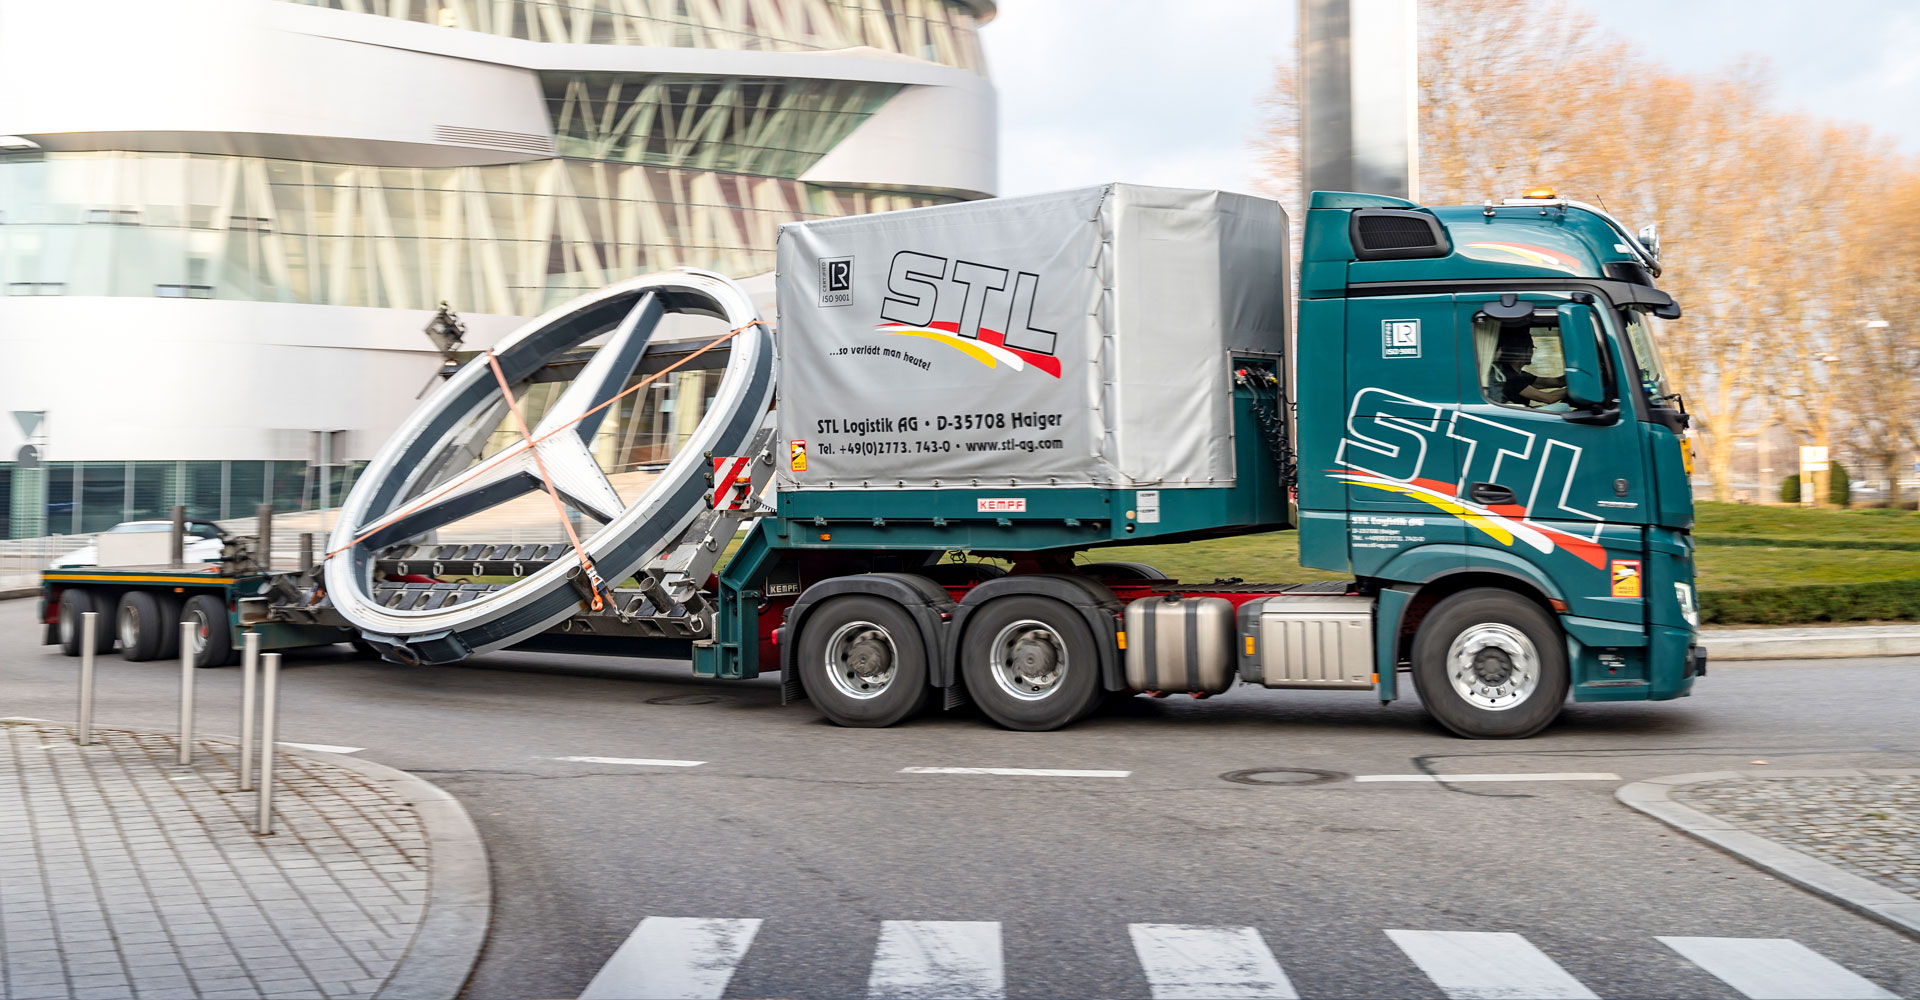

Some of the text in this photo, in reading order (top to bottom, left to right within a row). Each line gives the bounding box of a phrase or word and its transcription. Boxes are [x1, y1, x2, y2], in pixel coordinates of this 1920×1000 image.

[822, 294, 850, 303] ISO 9001
[880, 250, 1058, 356] STL
[851, 345, 880, 356] verlädt
[883, 347, 901, 359] man
[903, 352, 932, 371] heute!
[817, 411, 1063, 437] STL Logistik AG D-35708 Haiger
[818, 438, 1064, 456] Tel. +49(0)2773. 743-0 www.stl-ag.com
[1334, 387, 1605, 544] STL
[979, 500, 1023, 510] KEMPF
[770, 584, 798, 594] KEMPF
